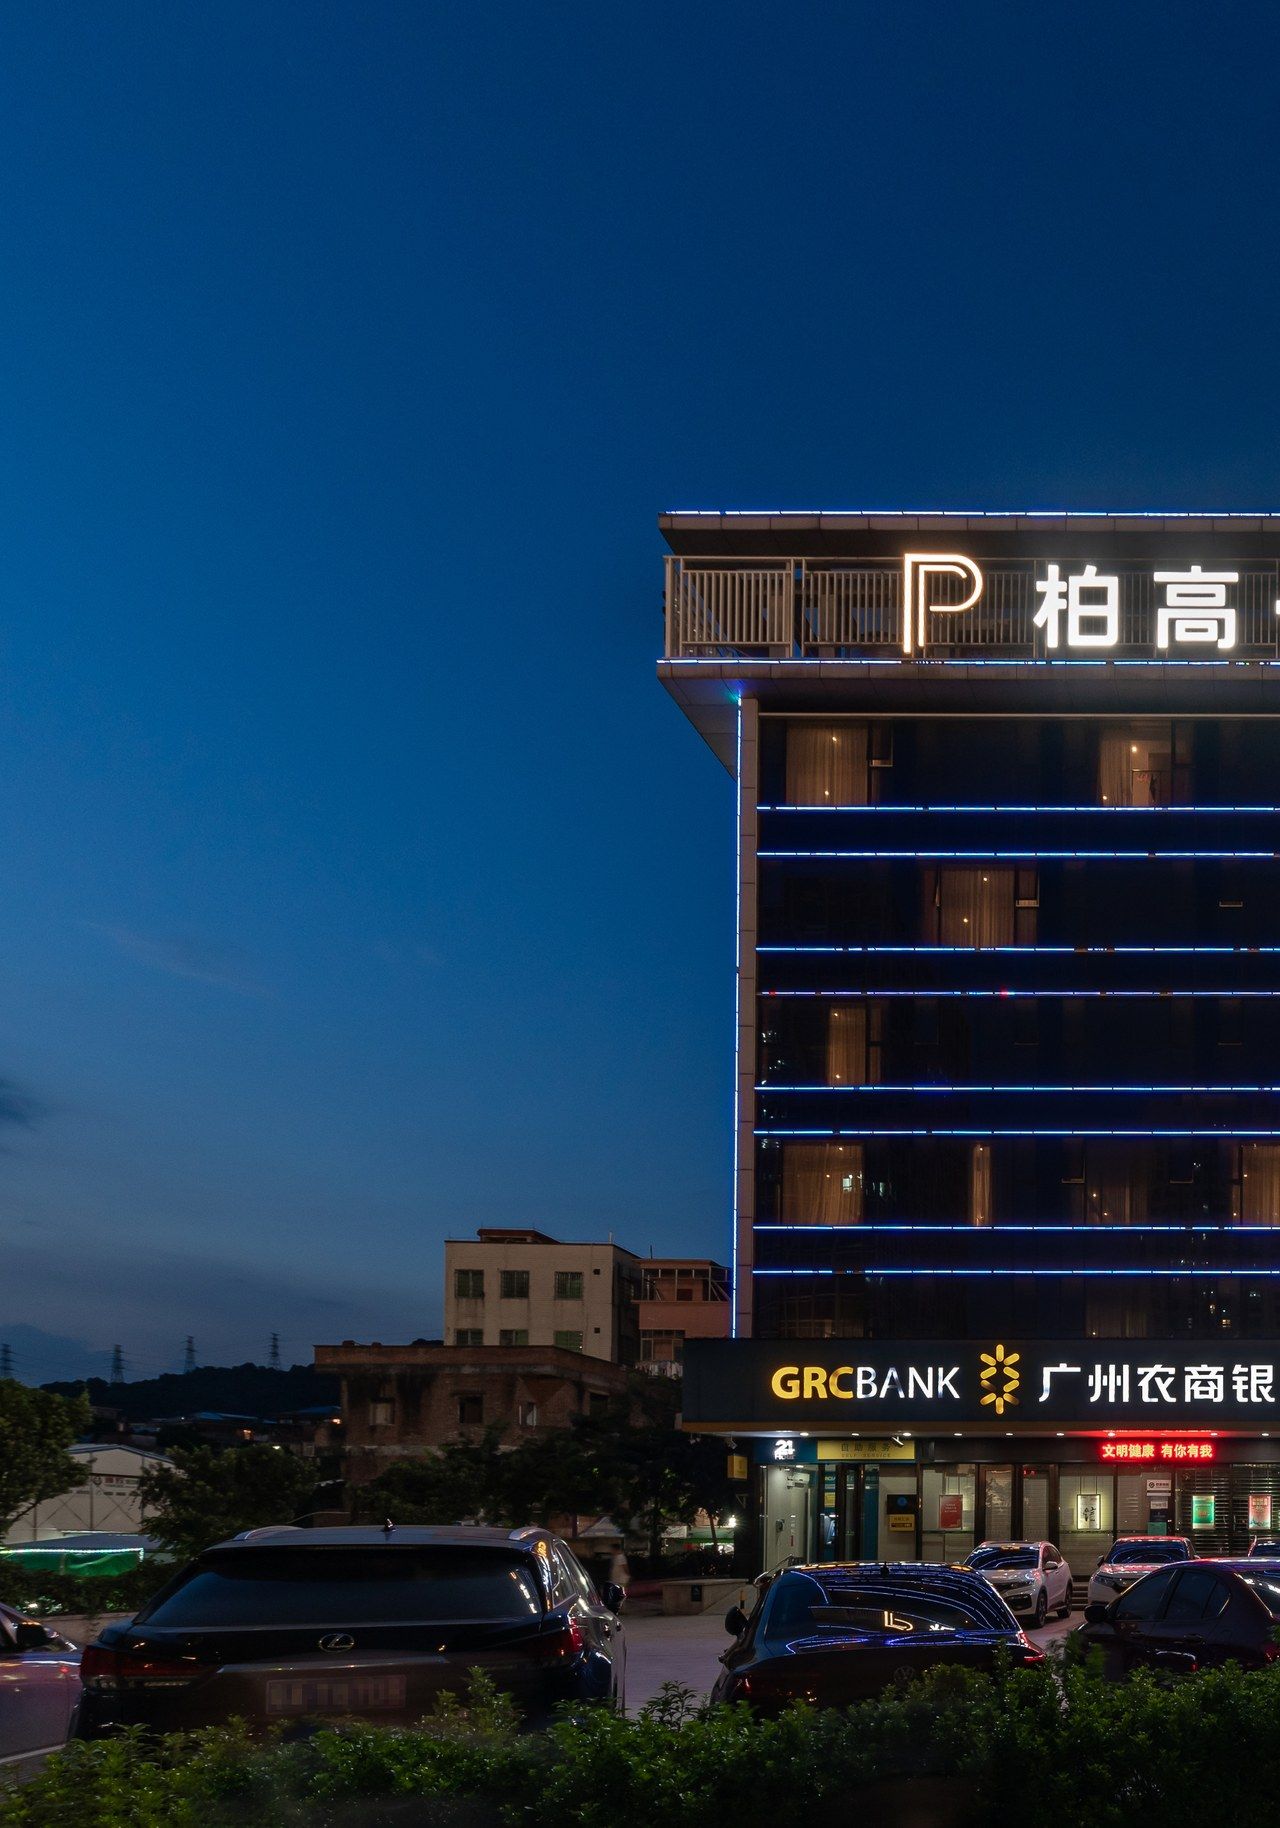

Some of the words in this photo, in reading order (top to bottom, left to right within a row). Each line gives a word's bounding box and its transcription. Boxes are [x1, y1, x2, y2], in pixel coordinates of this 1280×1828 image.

[771, 1366, 960, 1400] GRCBANK
[1102, 1444, 1155, 1458] 文明健康
[1161, 1444, 1213, 1458] 有你有我
